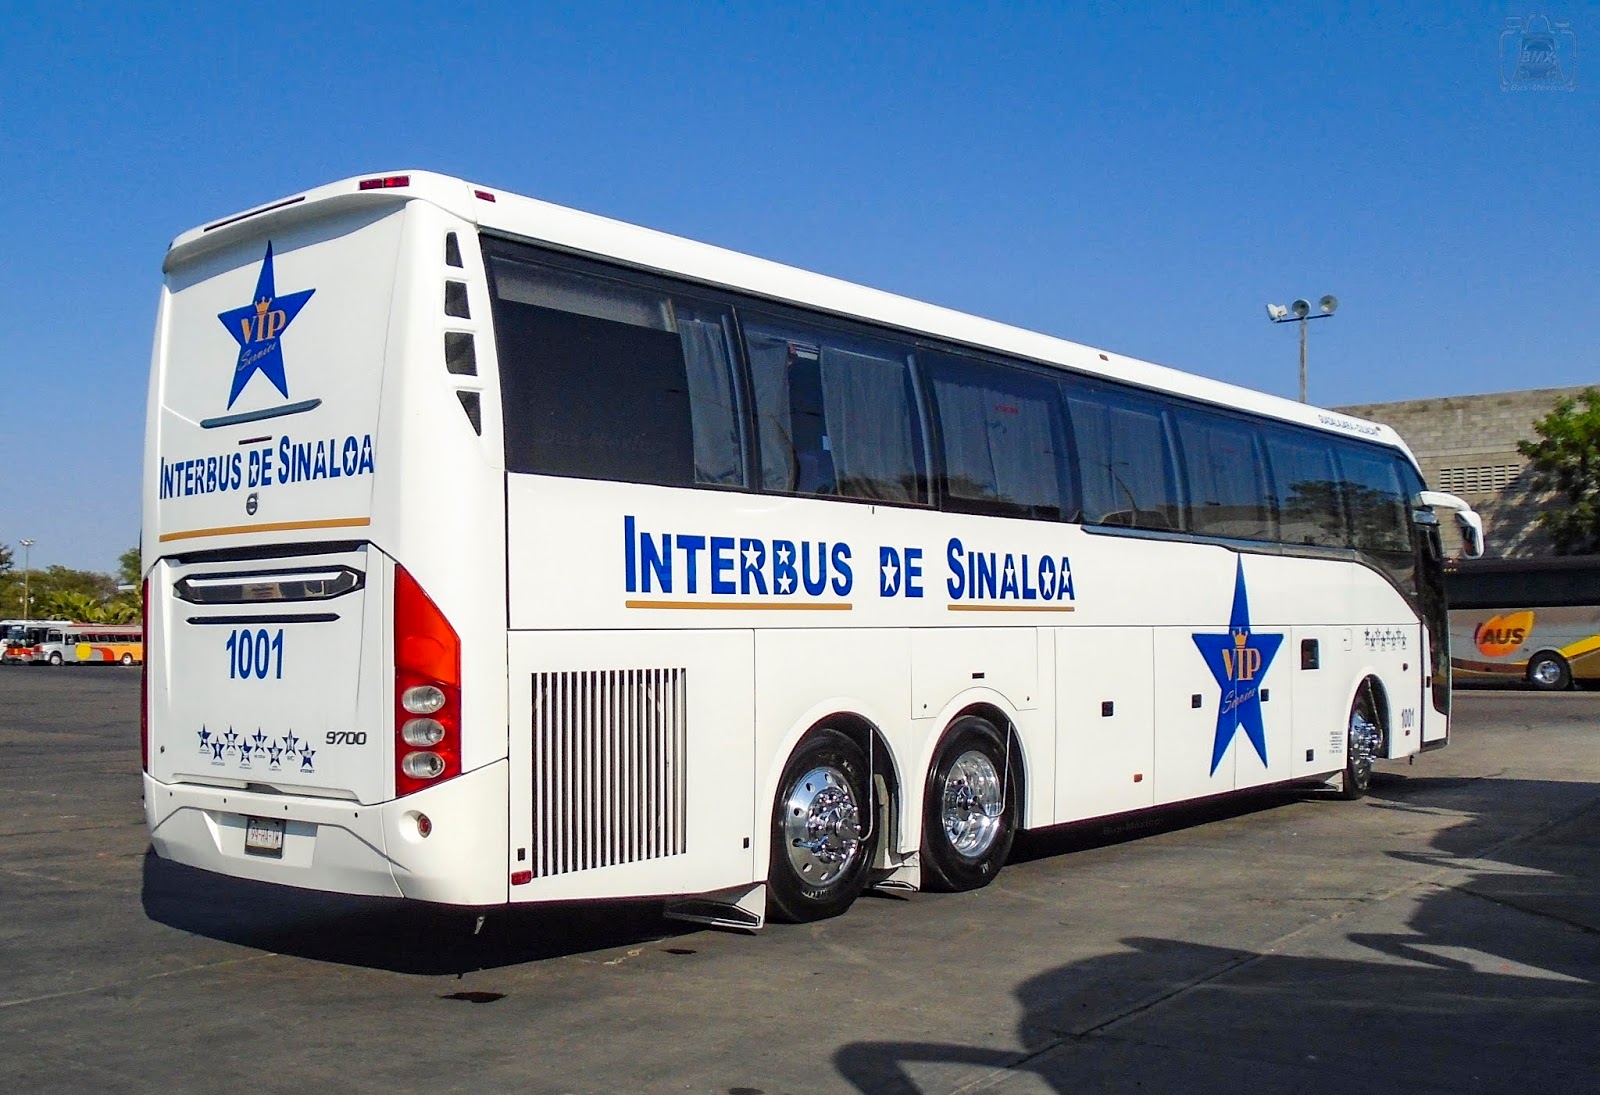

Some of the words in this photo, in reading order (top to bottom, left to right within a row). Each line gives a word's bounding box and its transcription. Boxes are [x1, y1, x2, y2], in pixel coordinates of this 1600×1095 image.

[241, 309, 286, 344] VIP
[159, 453, 242, 499] INTERBUS
[249, 448, 273, 488] DE
[277, 434, 374, 483] SINALOA
[624, 515, 853, 597] INTERBUS
[879, 546, 924, 598] DE
[946, 537, 1076, 601] SINALOA
[1480, 627, 1525, 645] AUS
[226, 629, 284, 679] 1001
[1222, 648, 1261, 681] VIP
[1401, 708, 1415, 729] 1001
[325, 731, 367, 745] 9700
